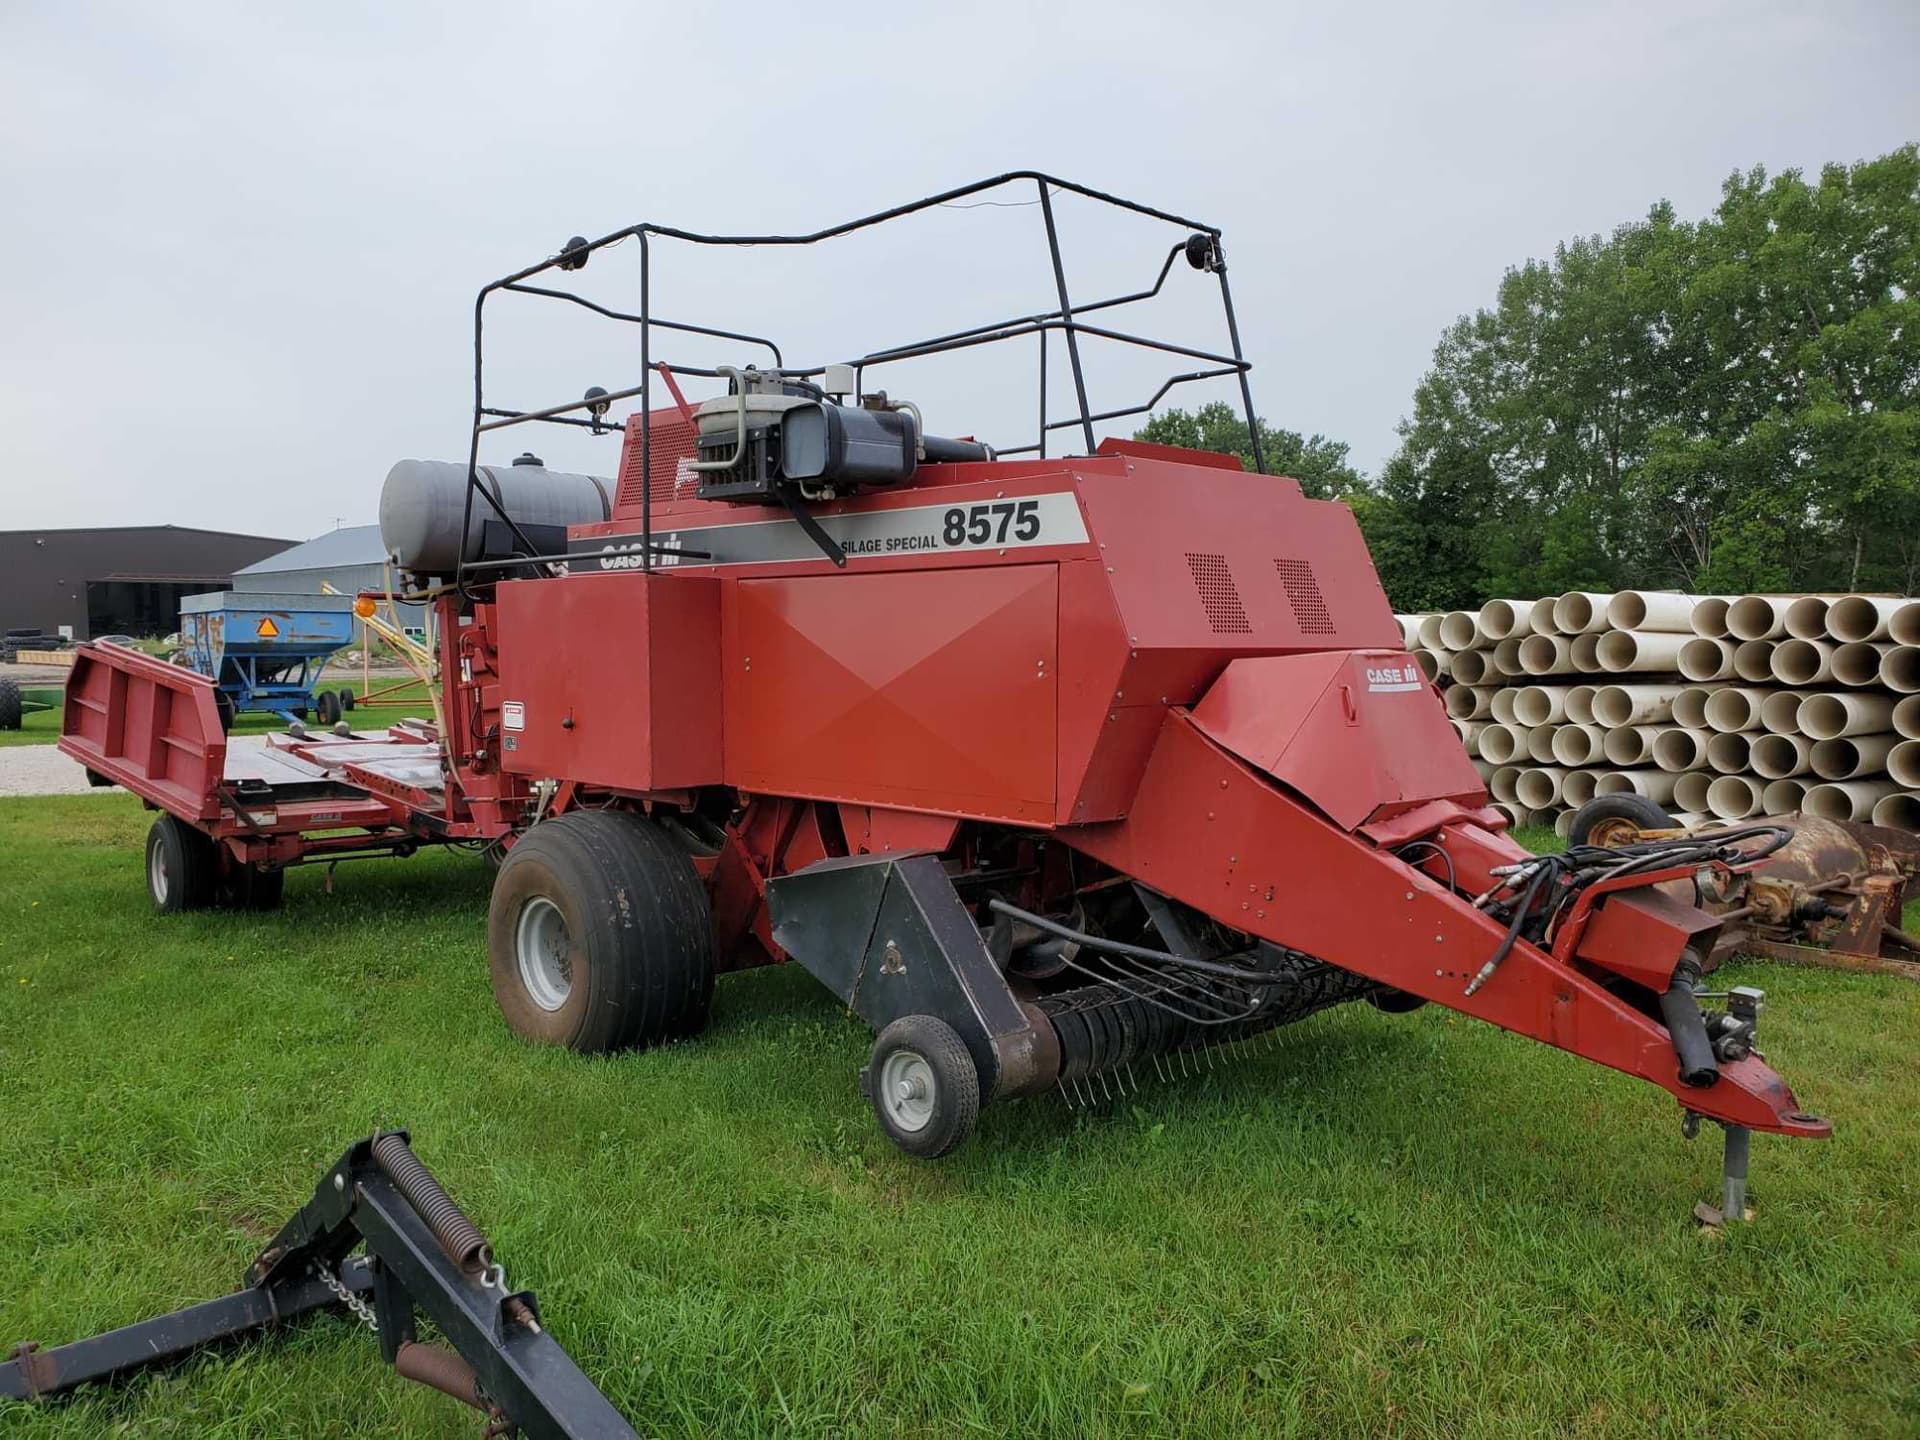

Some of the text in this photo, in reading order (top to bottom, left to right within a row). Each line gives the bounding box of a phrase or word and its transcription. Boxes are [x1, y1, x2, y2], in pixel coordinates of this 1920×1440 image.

[841, 501, 1041, 554] SILAGE SPECIAL 8575
[1366, 668, 1402, 683] CASE
